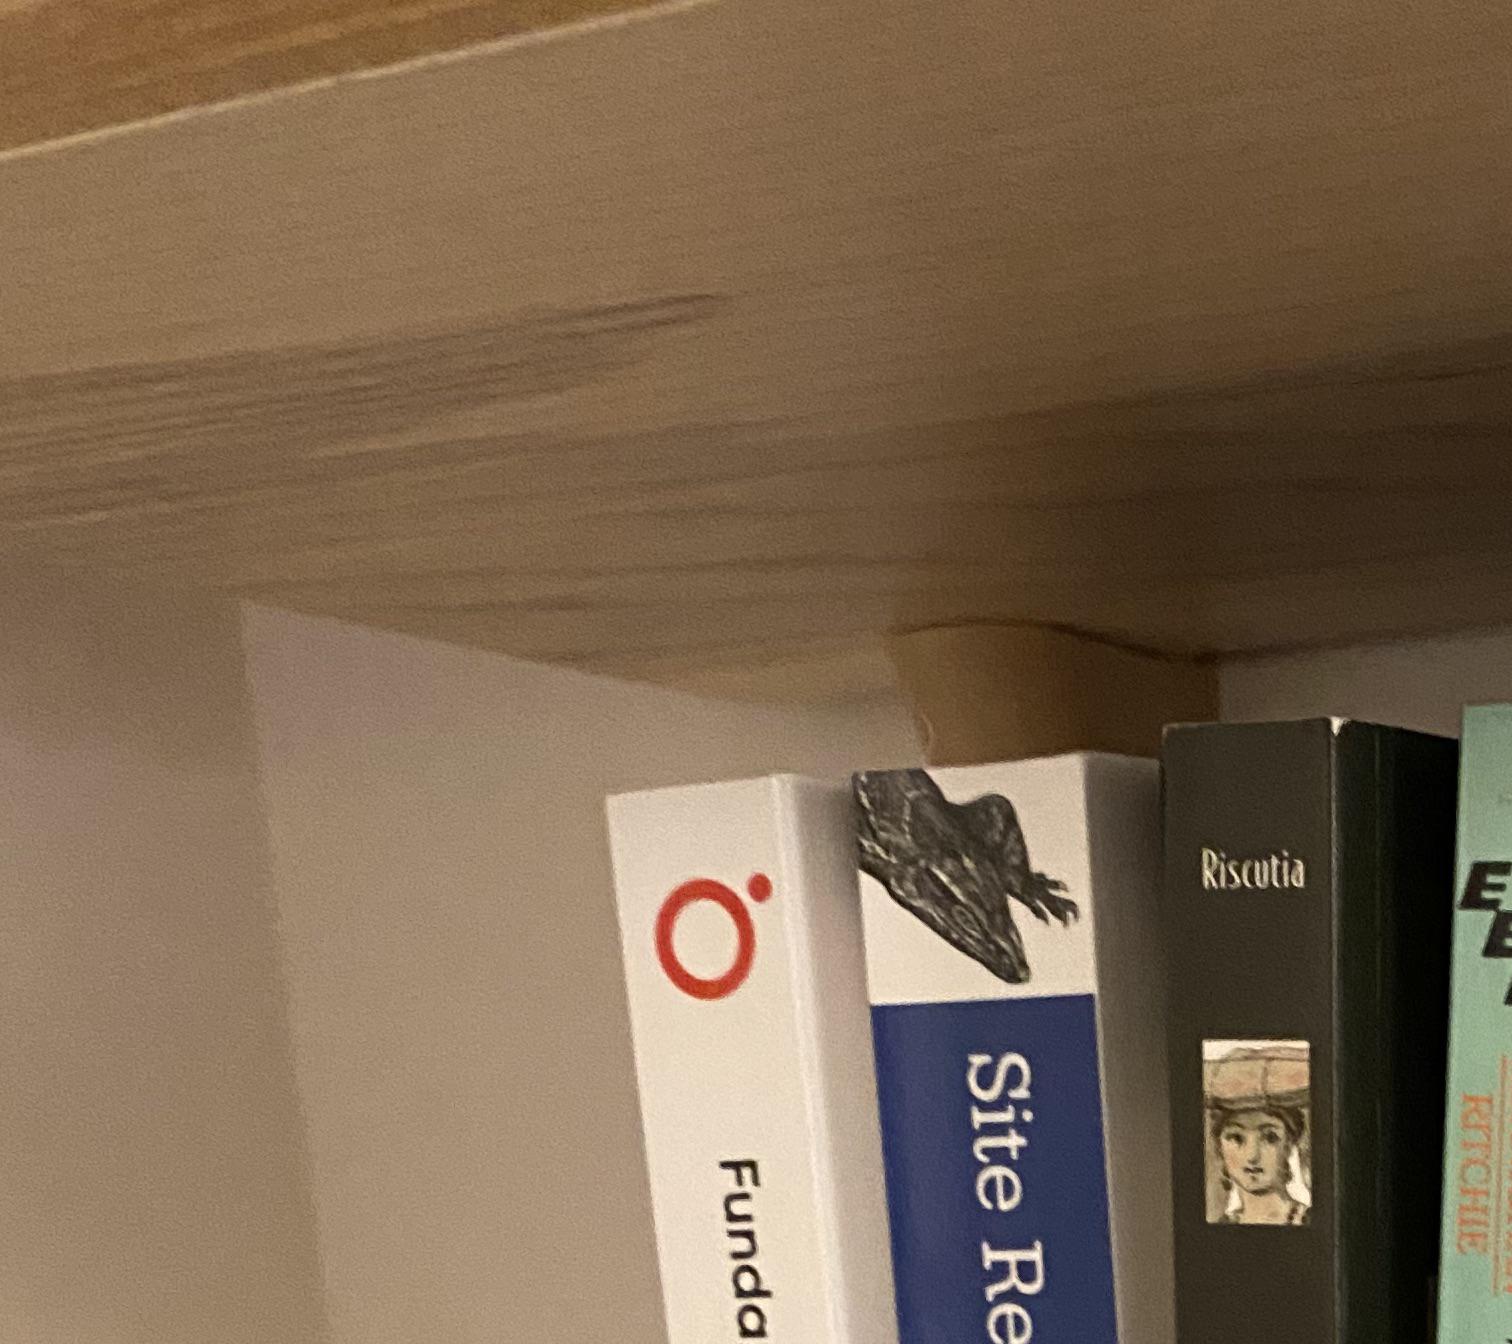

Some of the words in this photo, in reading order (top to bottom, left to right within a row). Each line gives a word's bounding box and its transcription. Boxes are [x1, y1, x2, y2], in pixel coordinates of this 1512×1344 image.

[1202, 847, 1305, 891] Riscutia
[966, 1051, 1032, 1213] Site
[1457, 1092, 1493, 1255] RITCHIE
